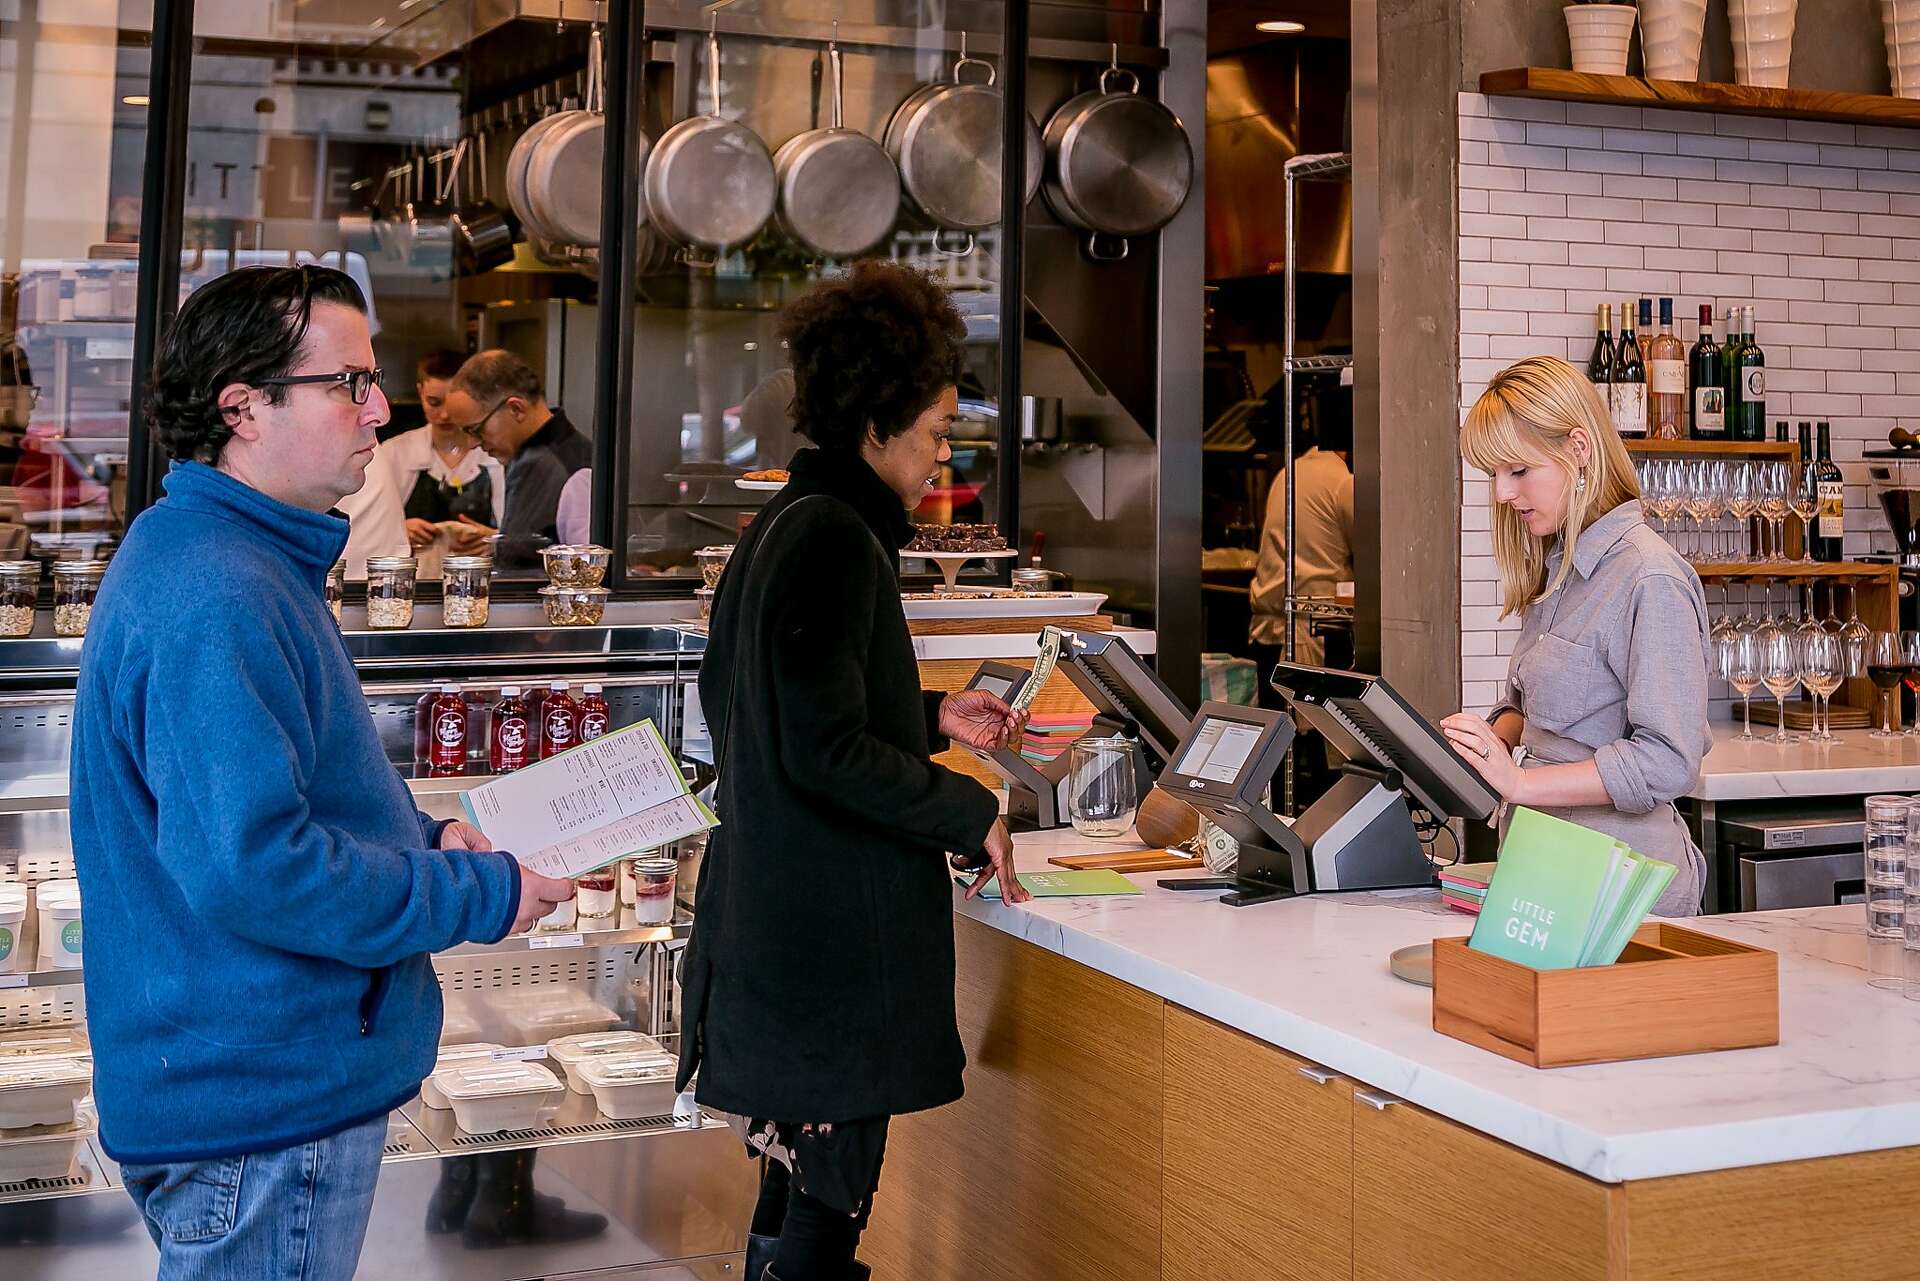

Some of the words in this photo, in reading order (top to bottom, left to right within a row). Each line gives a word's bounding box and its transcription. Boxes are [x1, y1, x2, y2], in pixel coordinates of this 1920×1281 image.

[190, 162, 352, 203] ITLE
[1511, 897, 1556, 925] LITTLE
[1505, 916, 1549, 951] GEM
